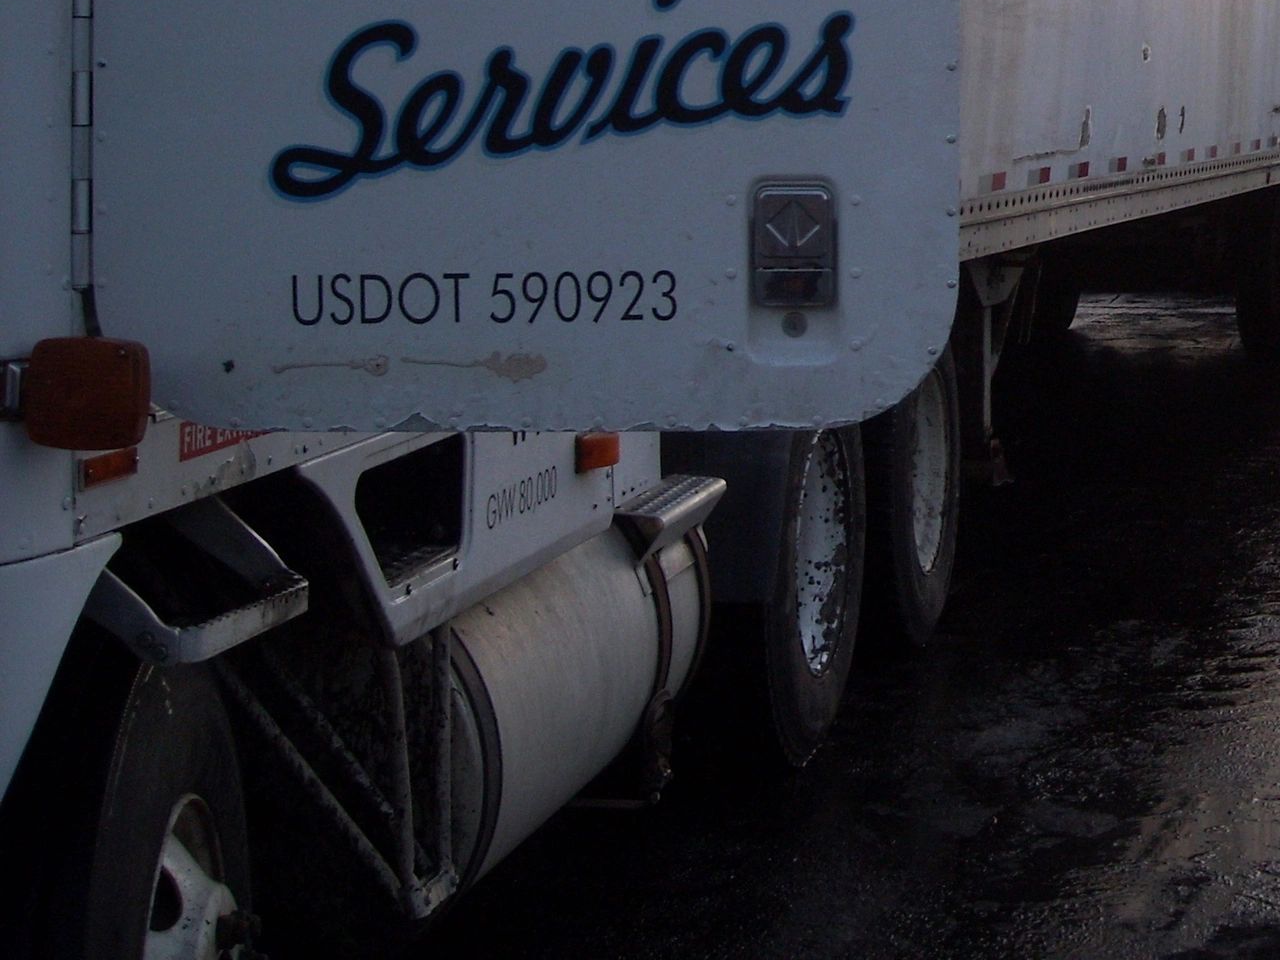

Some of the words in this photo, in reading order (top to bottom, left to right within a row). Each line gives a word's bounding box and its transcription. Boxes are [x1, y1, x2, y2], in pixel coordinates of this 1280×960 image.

[292, 273, 470, 325] USDOT
[490, 270, 677, 323] 590923
[184, 424, 212, 453] FIRE
[486, 484, 516, 529] GVW
[519, 466, 557, 514] 80,000
